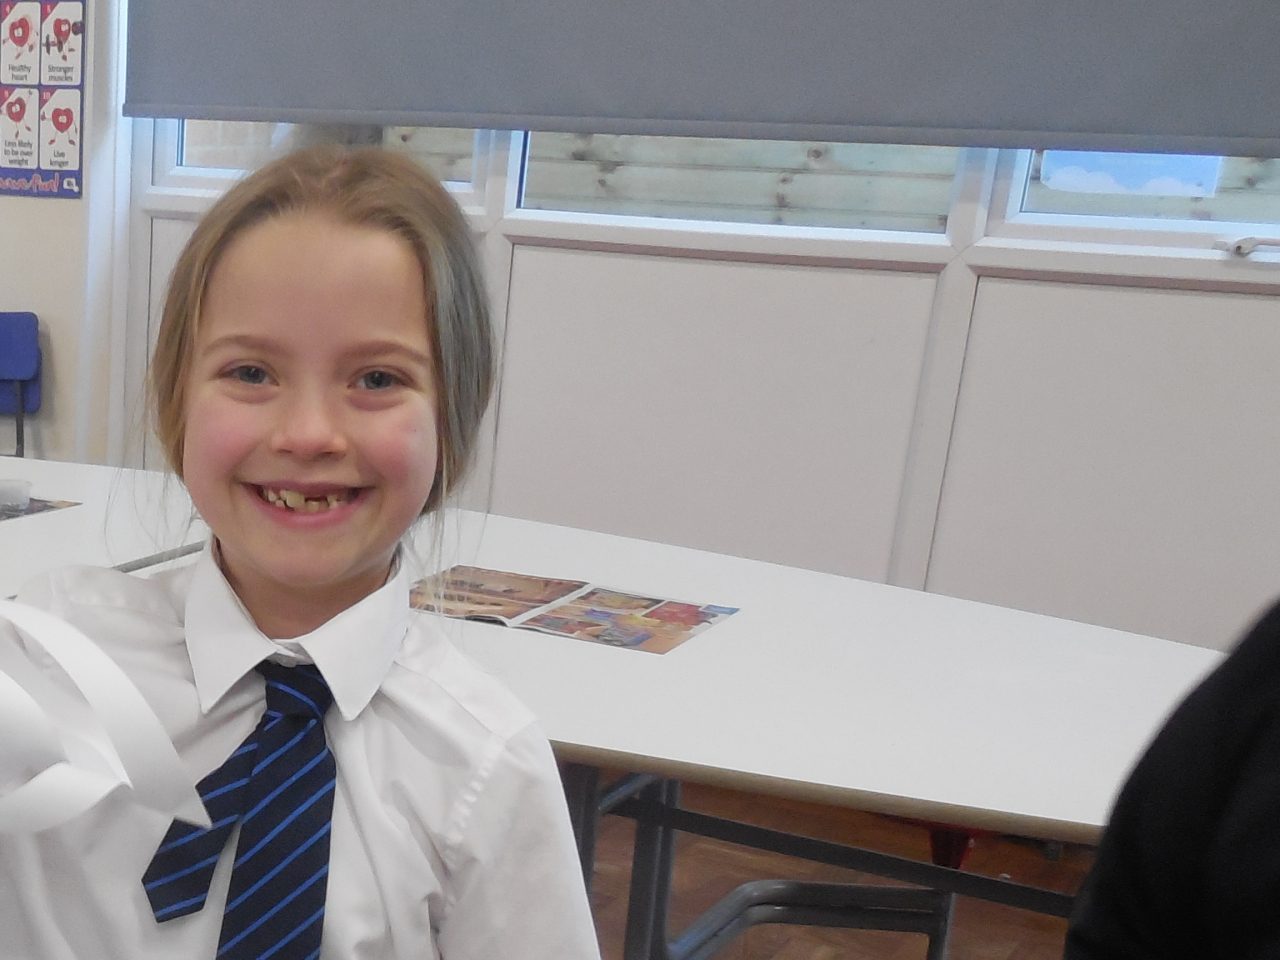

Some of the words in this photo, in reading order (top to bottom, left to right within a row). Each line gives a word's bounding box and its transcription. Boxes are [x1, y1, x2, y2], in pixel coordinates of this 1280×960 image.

[8, 64, 32, 73] Healthy
[48, 65, 74, 73] Stronger
[12, 73, 28, 81] heart
[53, 150, 65, 158] Live
[8, 158, 29, 166] weight
[50, 159, 69, 168] longer
